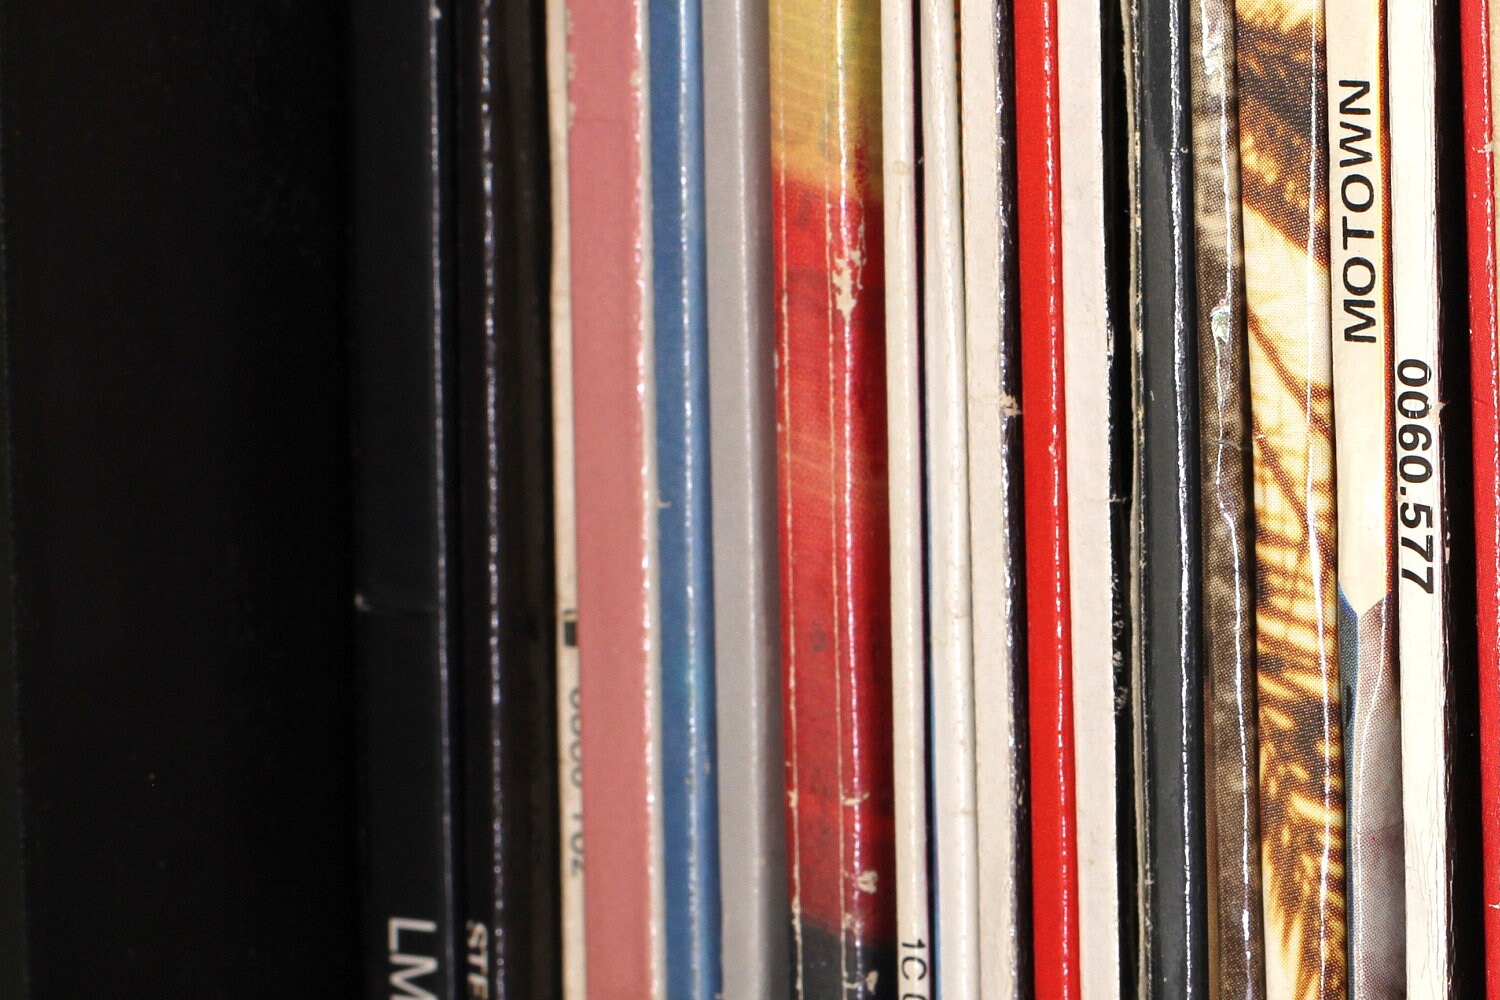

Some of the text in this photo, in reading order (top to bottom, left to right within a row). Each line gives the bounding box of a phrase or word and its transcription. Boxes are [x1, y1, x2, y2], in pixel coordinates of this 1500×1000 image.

[1339, 79, 1377, 344] MOTOWN
[1396, 358, 1434, 595] 0060.577
[901, 938, 928, 981] 1C
